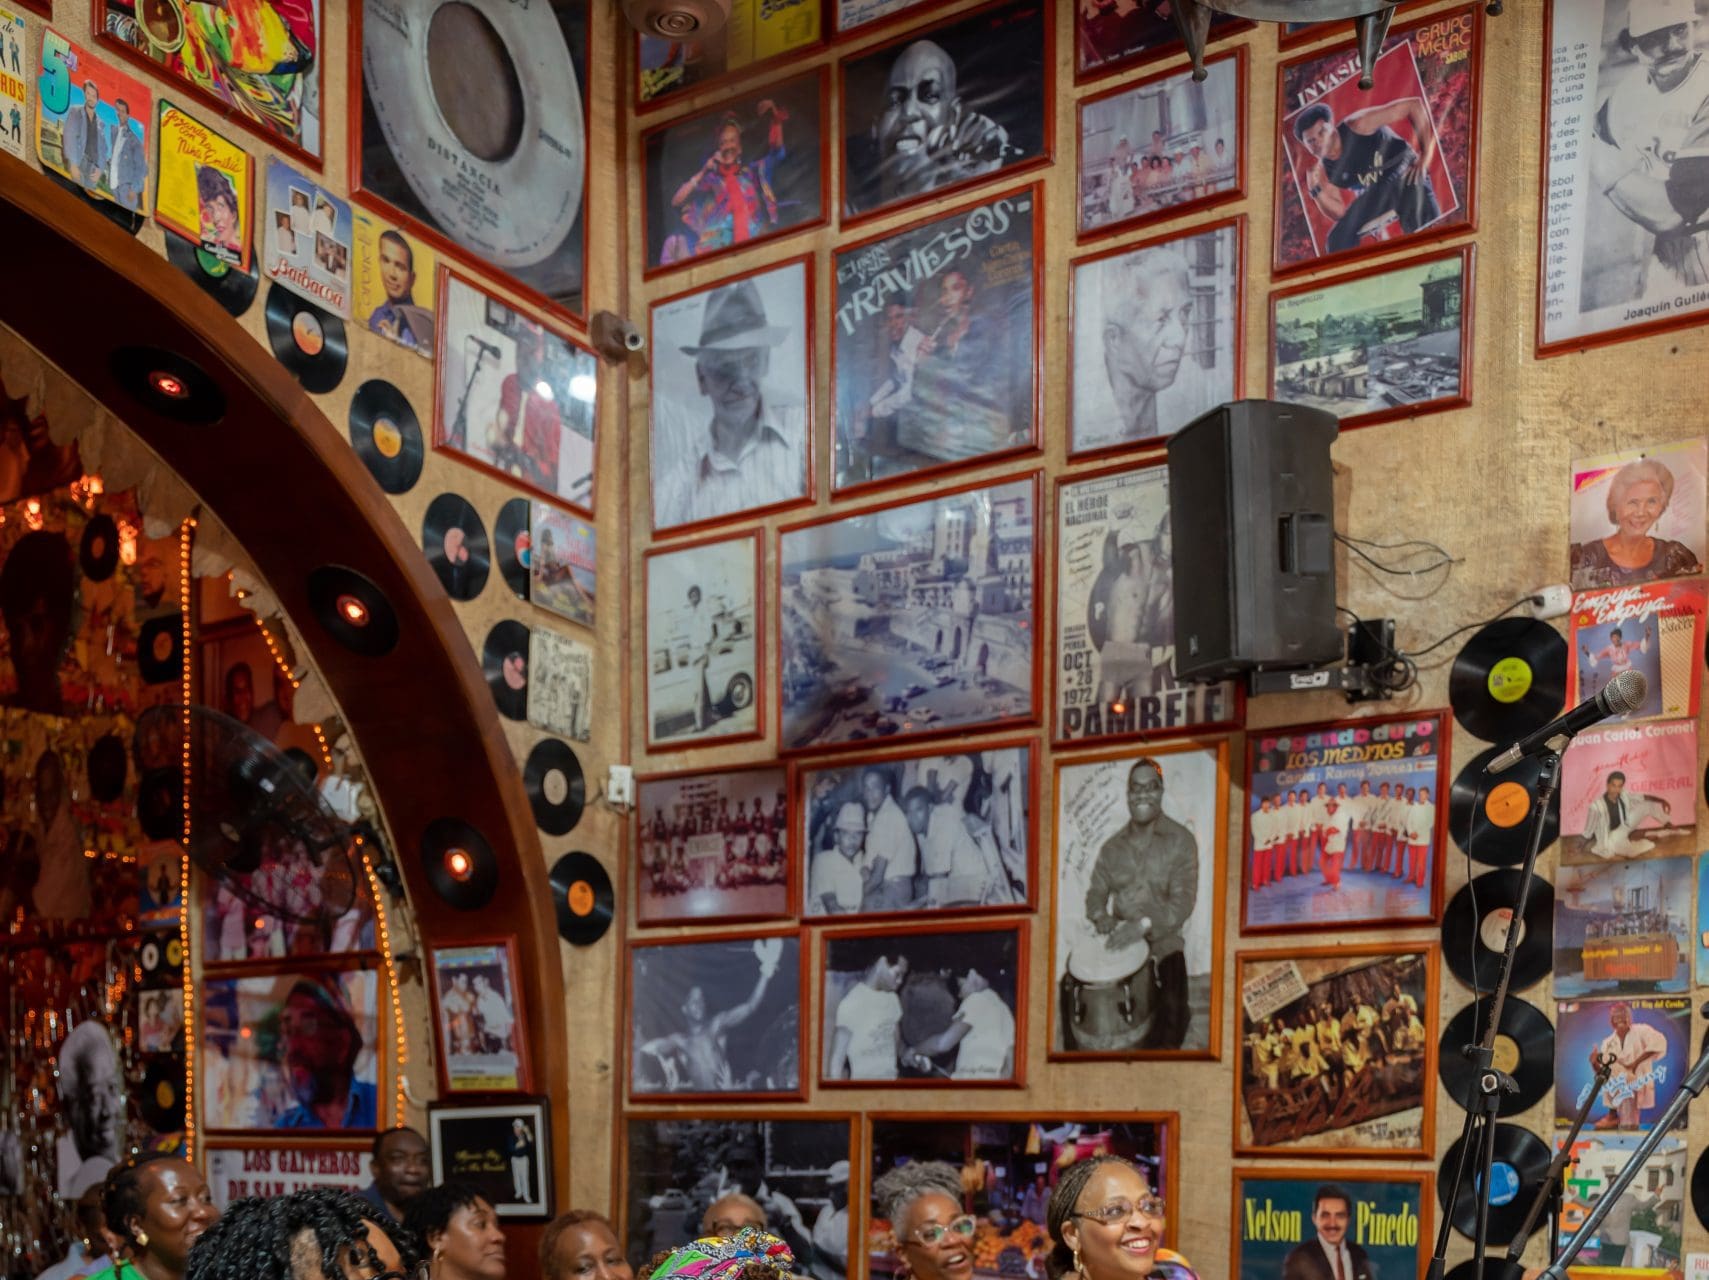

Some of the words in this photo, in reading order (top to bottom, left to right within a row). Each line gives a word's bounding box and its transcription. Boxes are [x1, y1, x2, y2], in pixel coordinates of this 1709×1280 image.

[1575, 52, 1588, 61] en
[1562, 64, 1575, 73] en
[1577, 61, 1587, 70] la
[1558, 72, 1586, 84] cinco
[1564, 82, 1585, 94] una
[1563, 115, 1581, 126] del
[1564, 139, 1578, 149] en
[271, 257, 344, 308] Barbacoa
[1065, 502, 1075, 514] EL
[1064, 649, 1093, 671] OCT
[1077, 669, 1093, 687] 28
[1064, 686, 1092, 705] 1972
[1603, 729, 1643, 743] Carlos
[1645, 721, 1695, 737] Coronel
[1286, 750, 1319, 770] LOS
[242, 1149, 272, 1172] LOS
[278, 1150, 360, 1175] GAITEROS
[228, 1180, 248, 1201] DE
[1244, 1198, 1303, 1243] Nelson
[1356, 1200, 1419, 1248] Pinedo
